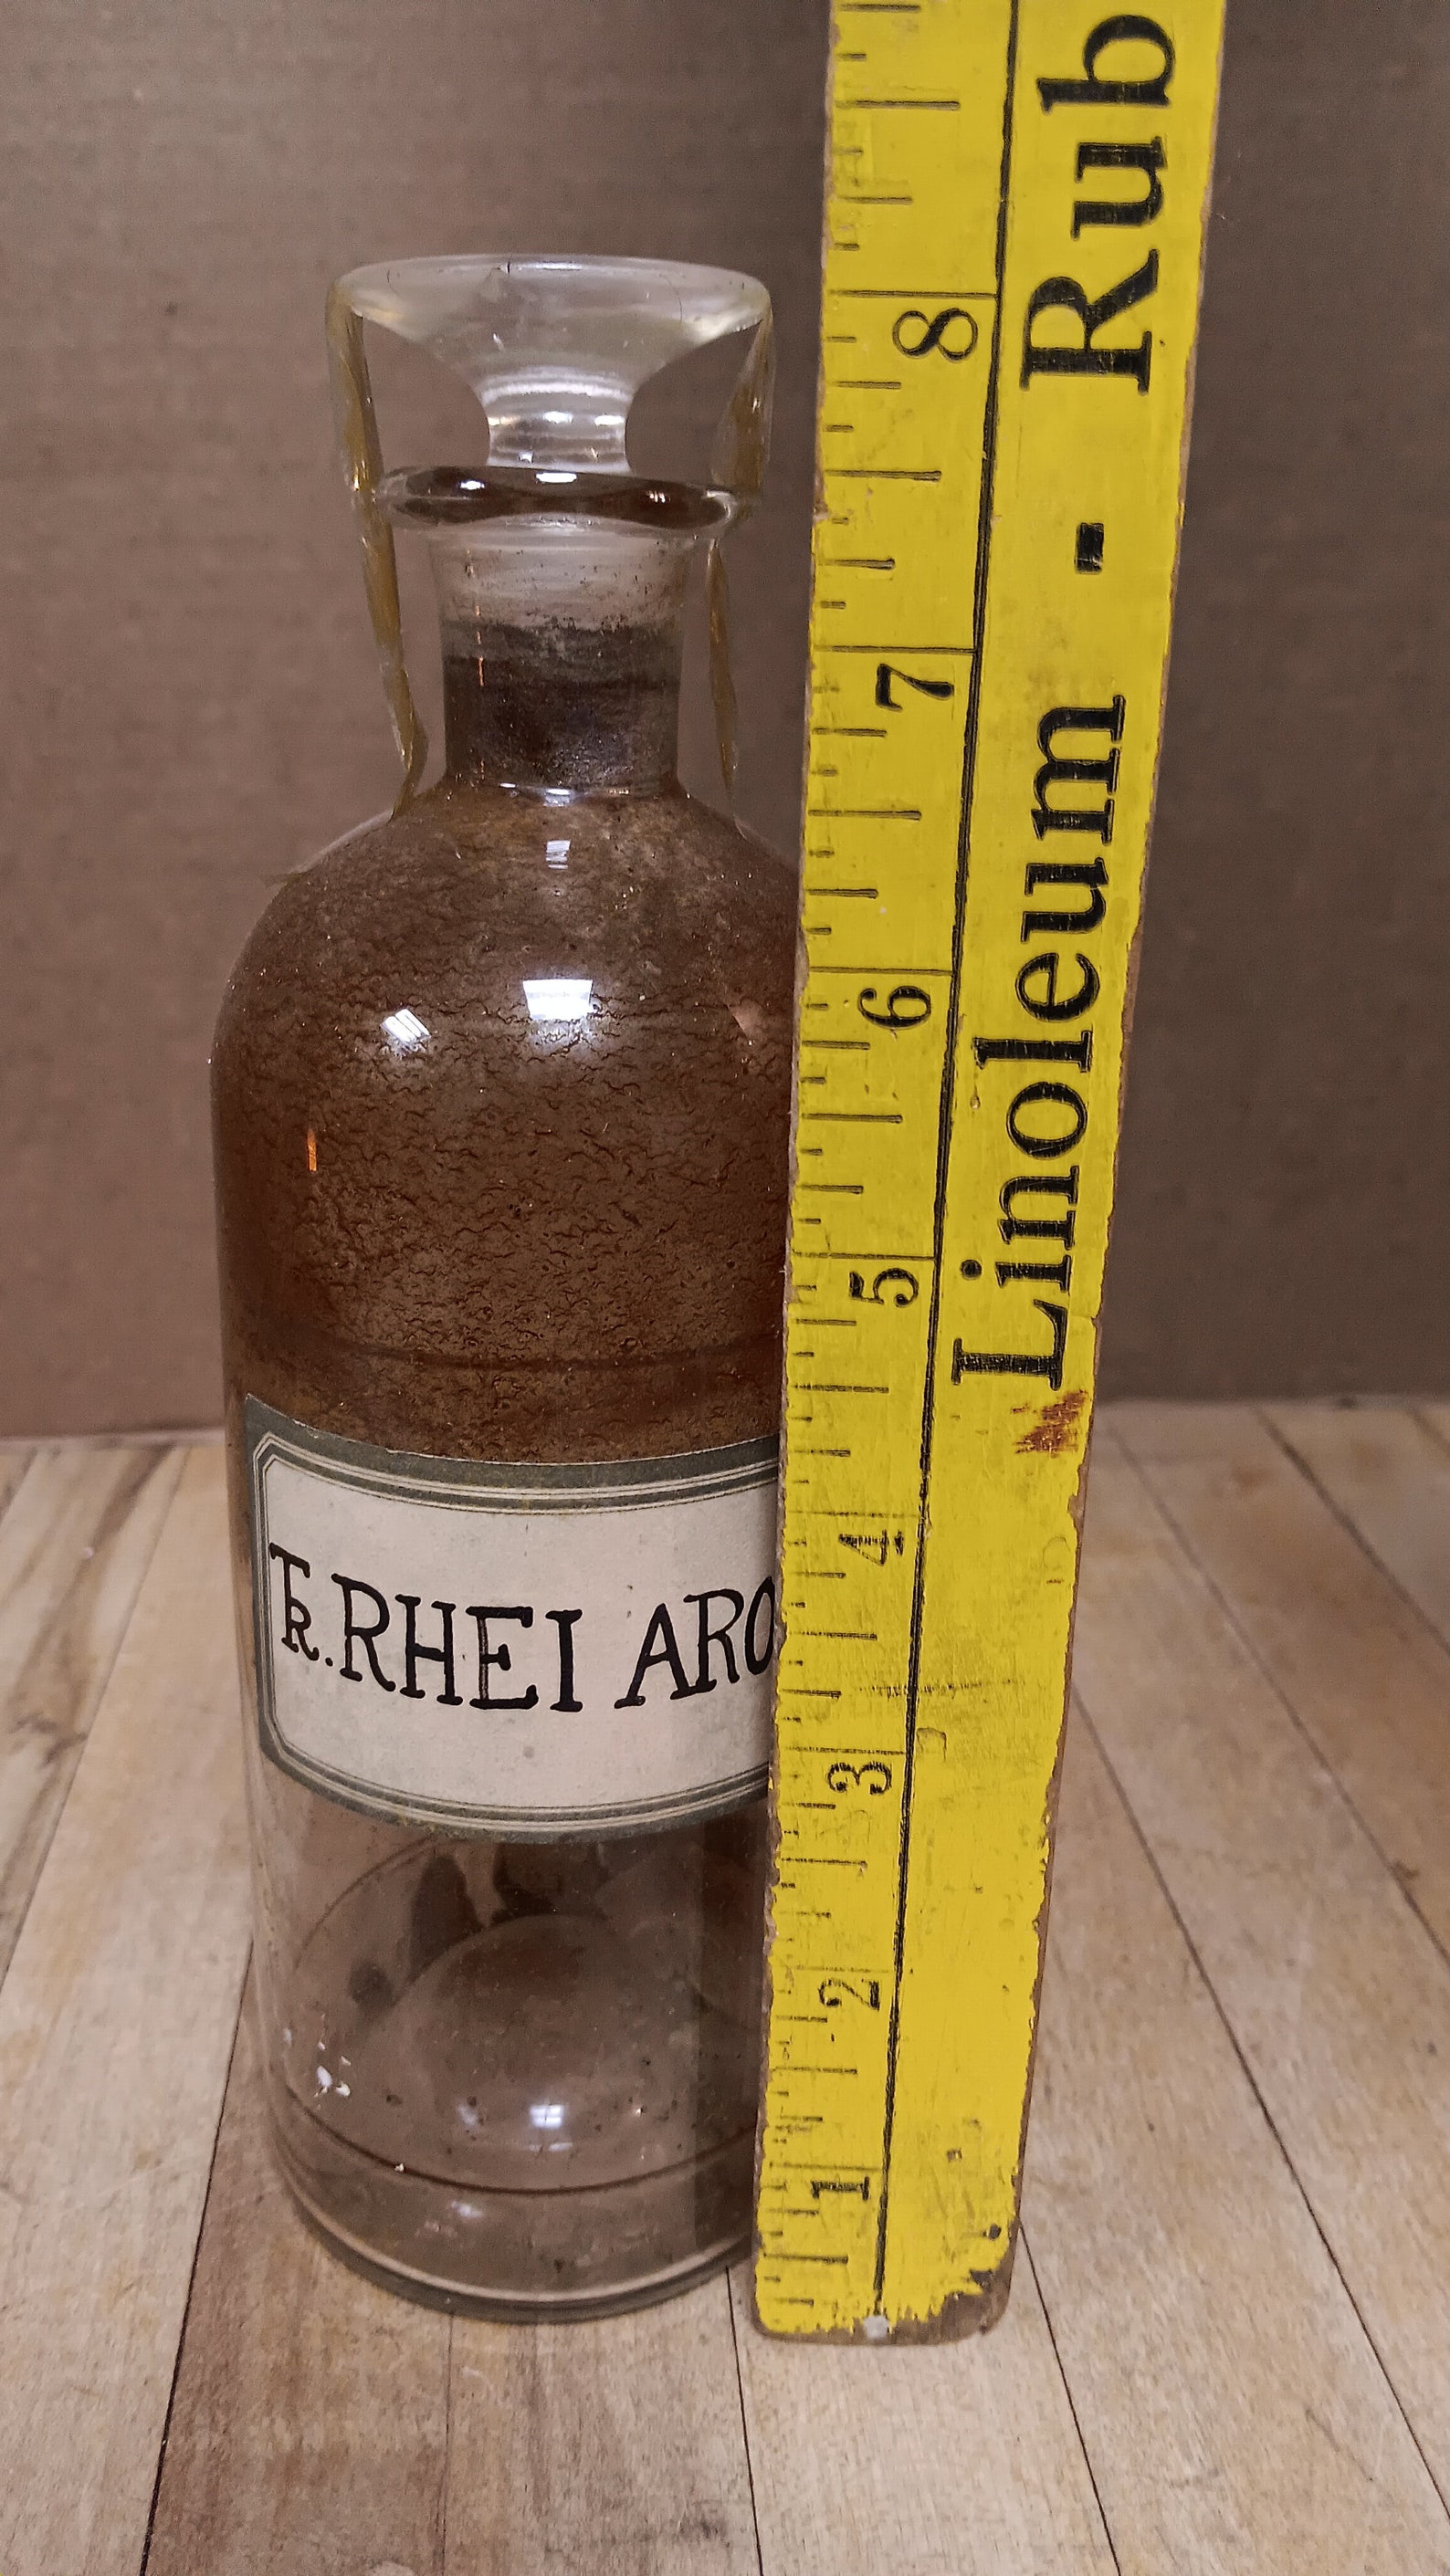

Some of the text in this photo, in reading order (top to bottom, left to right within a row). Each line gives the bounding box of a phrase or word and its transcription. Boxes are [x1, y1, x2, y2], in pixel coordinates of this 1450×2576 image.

[1020, 15, 1175, 393] Rub
[893, 309, 978, 361] 8
[877, 665, 954, 711] 7
[859, 986, 931, 1031] 6
[952, 695, 1124, 1389] Linoleum
[850, 1268, 919, 1308] 5
[839, 1529, 904, 1565] 4
[615, 1576, 775, 1709] ARO
[827, 1760, 892, 1795] 3
[818, 1978, 881, 2011] 2
[812, 2178, 870, 2201] 1
